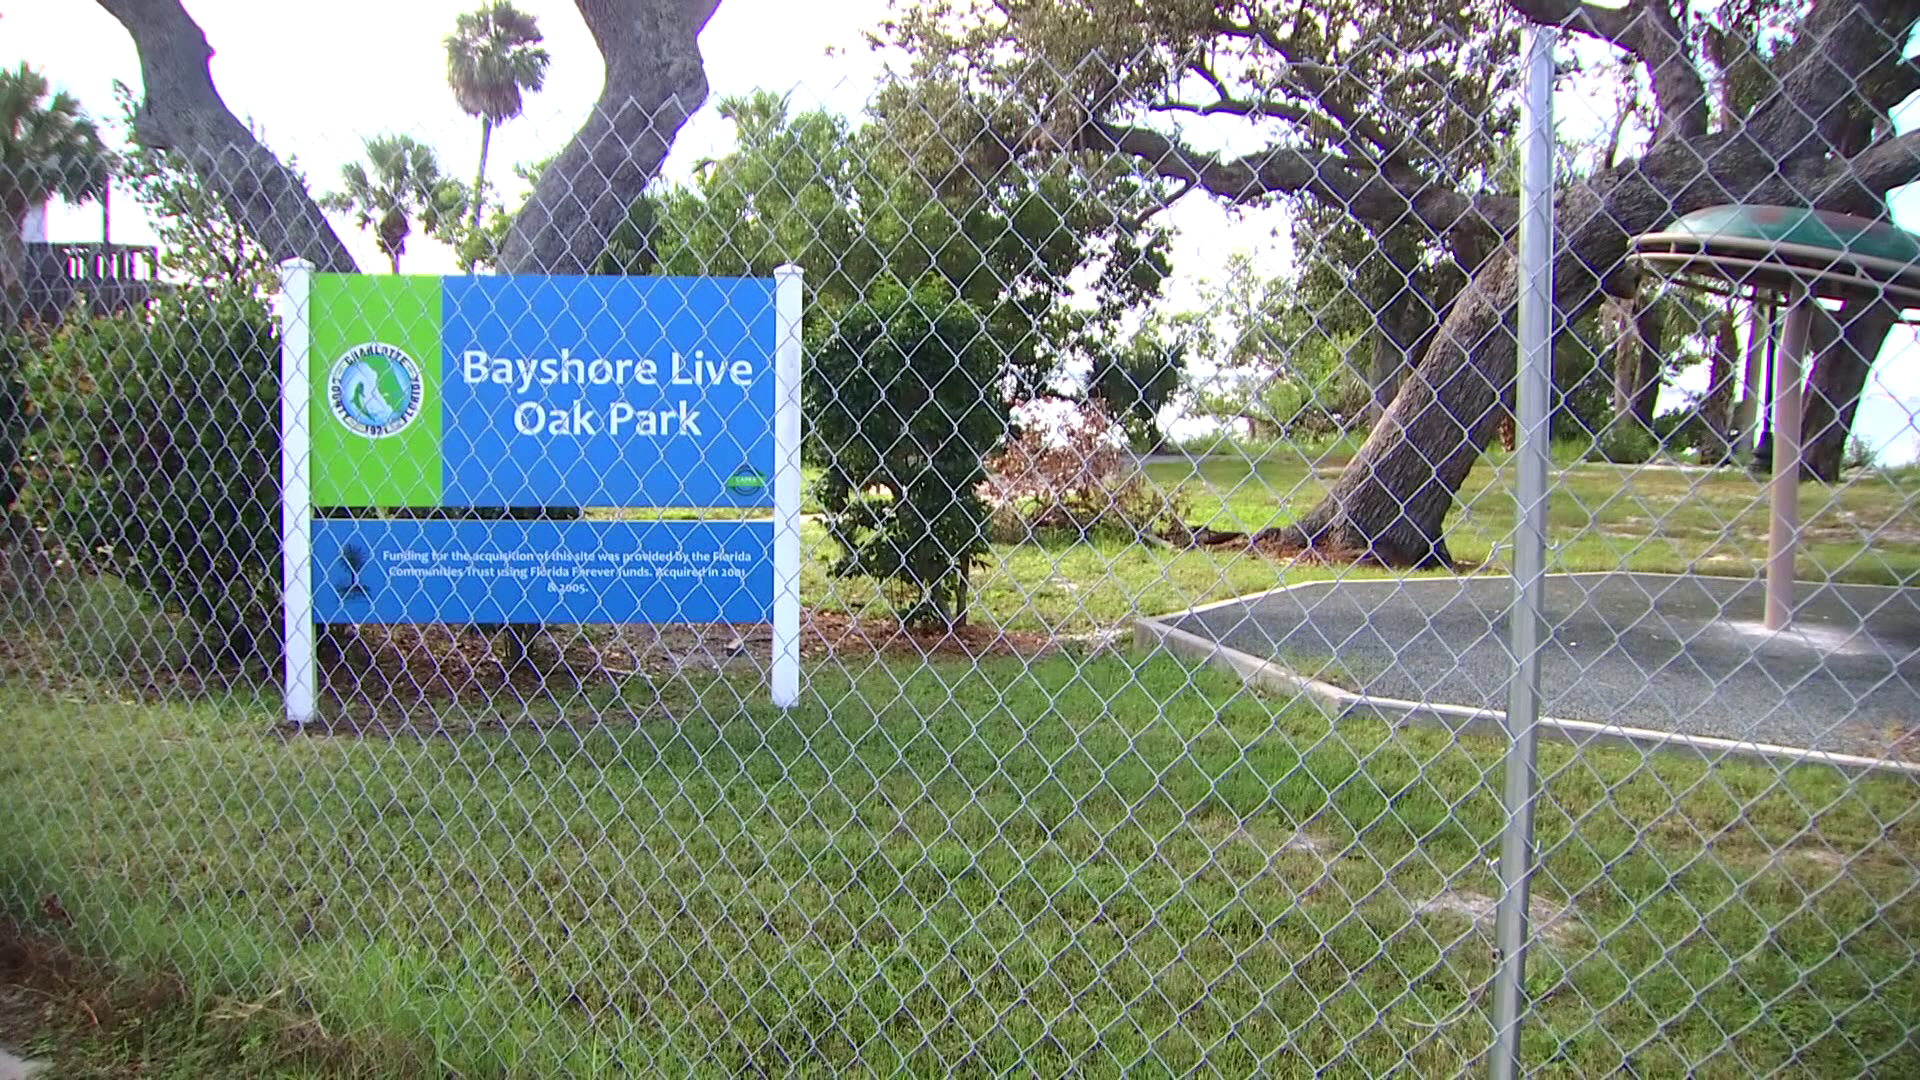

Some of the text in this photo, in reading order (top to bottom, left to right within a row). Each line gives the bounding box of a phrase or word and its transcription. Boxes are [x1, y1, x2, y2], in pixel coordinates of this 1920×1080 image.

[344, 346, 408, 366] CHARLOTTE
[463, 348, 753, 394] Bayshore Live
[514, 400, 702, 436] Oak Park
[383, 550, 752, 565] Funding for the acquisition of this site was provided by the Florida
[388, 566, 464, 577] Communities
[467, 567, 495, 577] Trust
[496, 566, 529, 579] using
[530, 566, 570, 577] Florida
[571, 566, 616, 577] Forever
[655, 566, 706, 580] Acquired
[708, 566, 720, 577] in
[559, 583, 589, 595] 2005.
